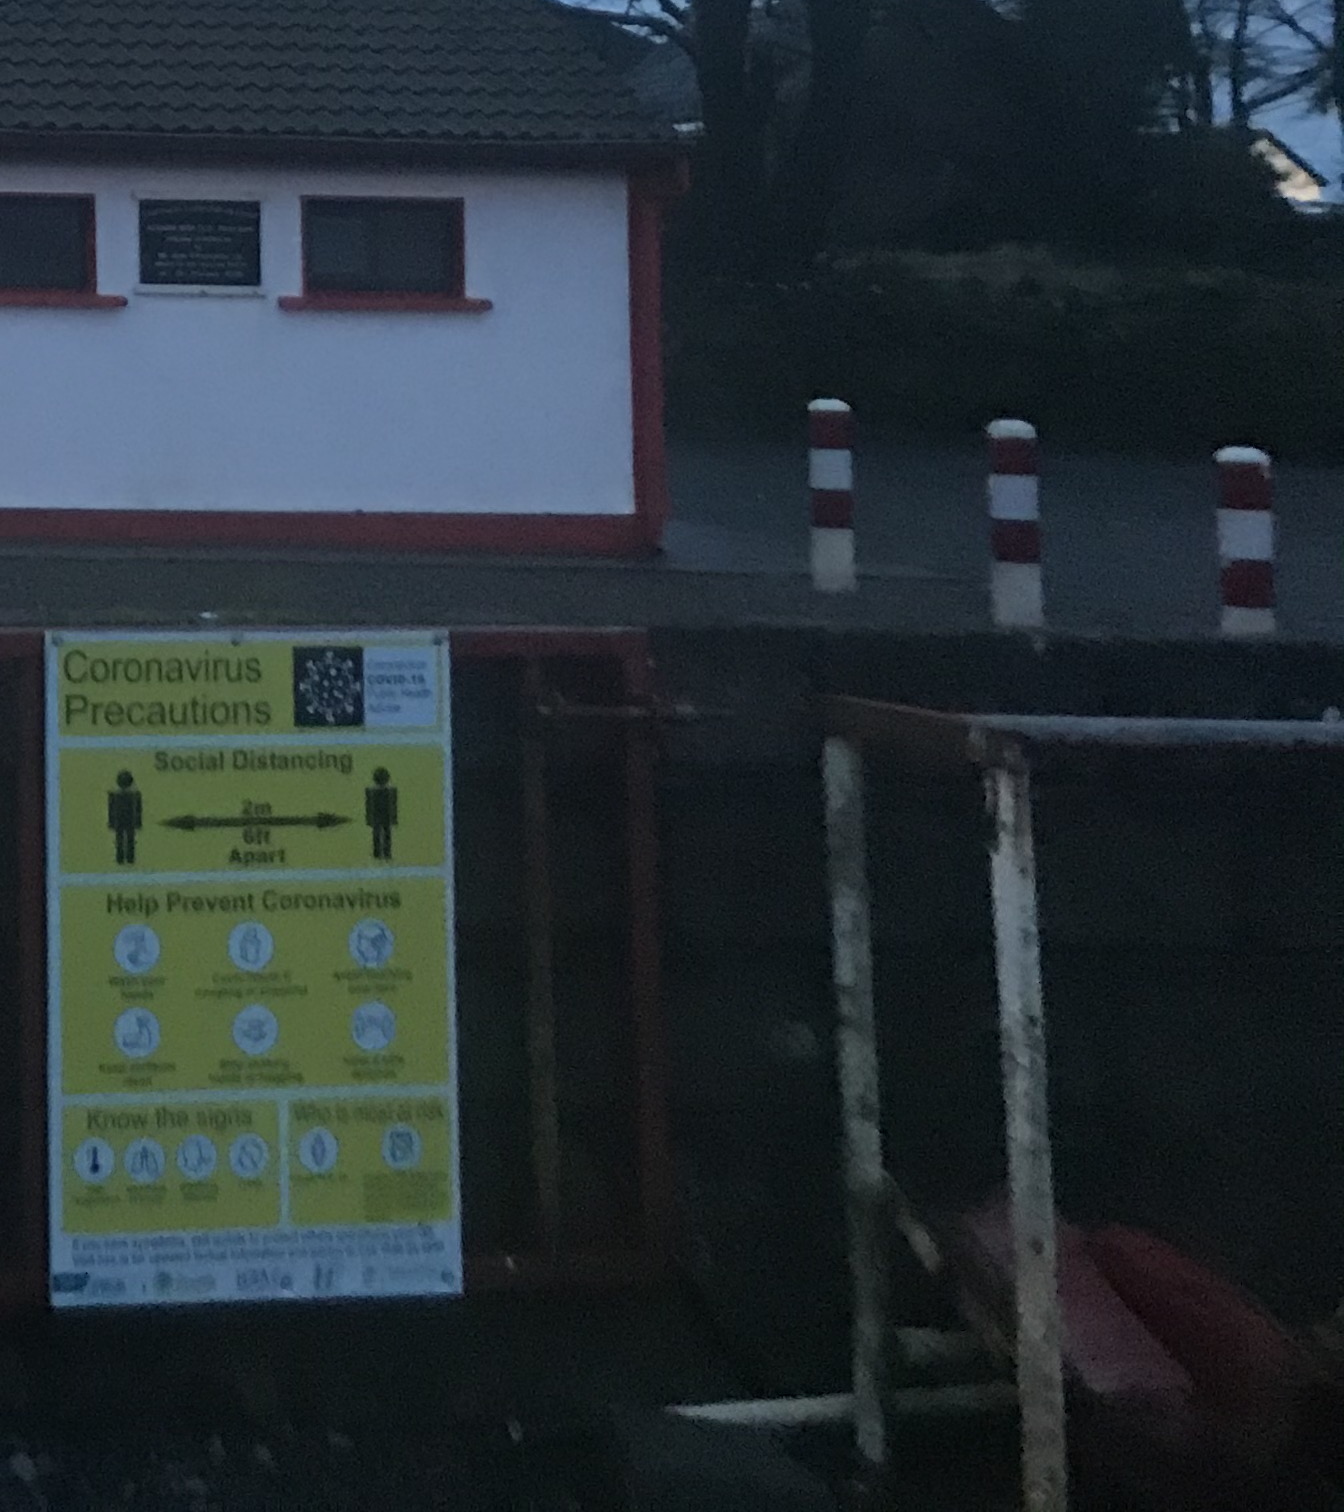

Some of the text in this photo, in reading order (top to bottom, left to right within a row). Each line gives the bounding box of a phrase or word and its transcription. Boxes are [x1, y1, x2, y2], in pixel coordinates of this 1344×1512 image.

[62, 648, 262, 685] Coronavirus
[64, 694, 272, 728] Precautions
[154, 749, 353, 775] Social Distancing
[241, 798, 272, 816] 2m
[242, 828, 272, 845] 6ft
[228, 848, 286, 866] Apart
[106, 888, 402, 916] Help Prevent Coronavirus
[87, 1108, 148, 1130] Know
[155, 1106, 189, 1128] the
